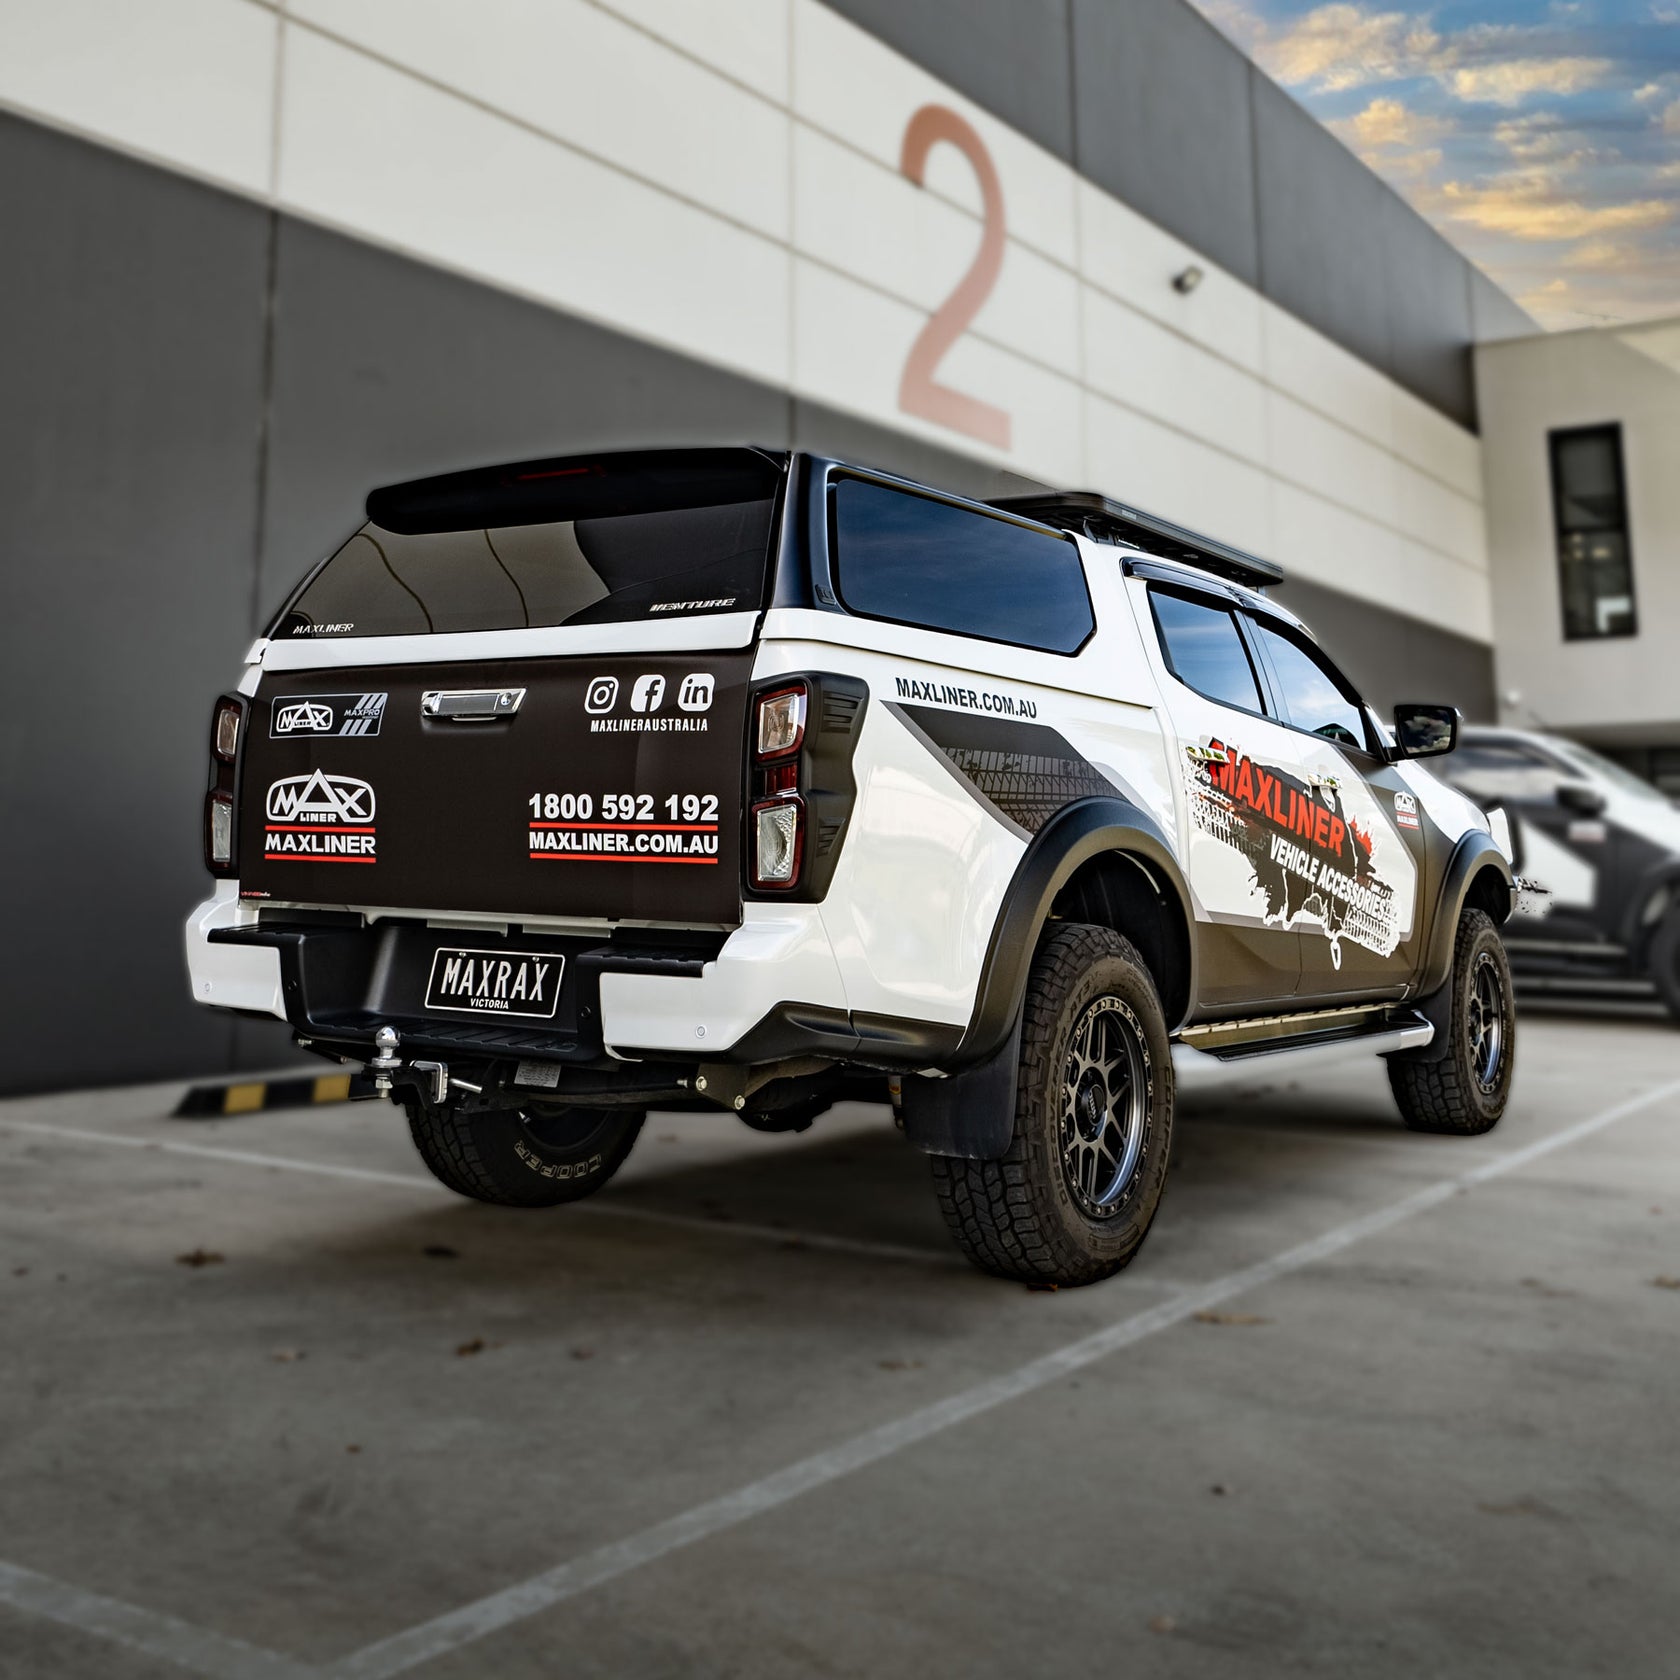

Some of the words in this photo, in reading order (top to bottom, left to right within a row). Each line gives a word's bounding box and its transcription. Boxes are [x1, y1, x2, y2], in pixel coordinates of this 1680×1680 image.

[898, 103, 1012, 452] 2
[649, 598, 736, 612] VENTURE
[293, 623, 354, 634] MAXLINER
[895, 677, 1037, 719] MAXLINER.COM.AU
[280, 701, 330, 728] MAX
[343, 709, 381, 717] MAXPRO
[591, 719, 708, 732] MAXLINERAUSTRALIA
[272, 768, 368, 815] MAX
[1208, 738, 1346, 858] MAXLINER
[300, 813, 337, 823] LINER
[529, 793, 593, 820] 1800
[601, 794, 654, 821] 592
[665, 794, 719, 821] 192
[265, 833, 376, 854] MAXLINER
[529, 832, 719, 854] MAXLINER.COM.AU
[1269, 834, 1319, 884] VEHICLE
[1317, 862, 1386, 922] ACCESSORIES
[441, 957, 550, 1001] MAXRAX
[470, 998, 509, 1010] VICTORIA
[514, 1140, 602, 1179] COOPER
